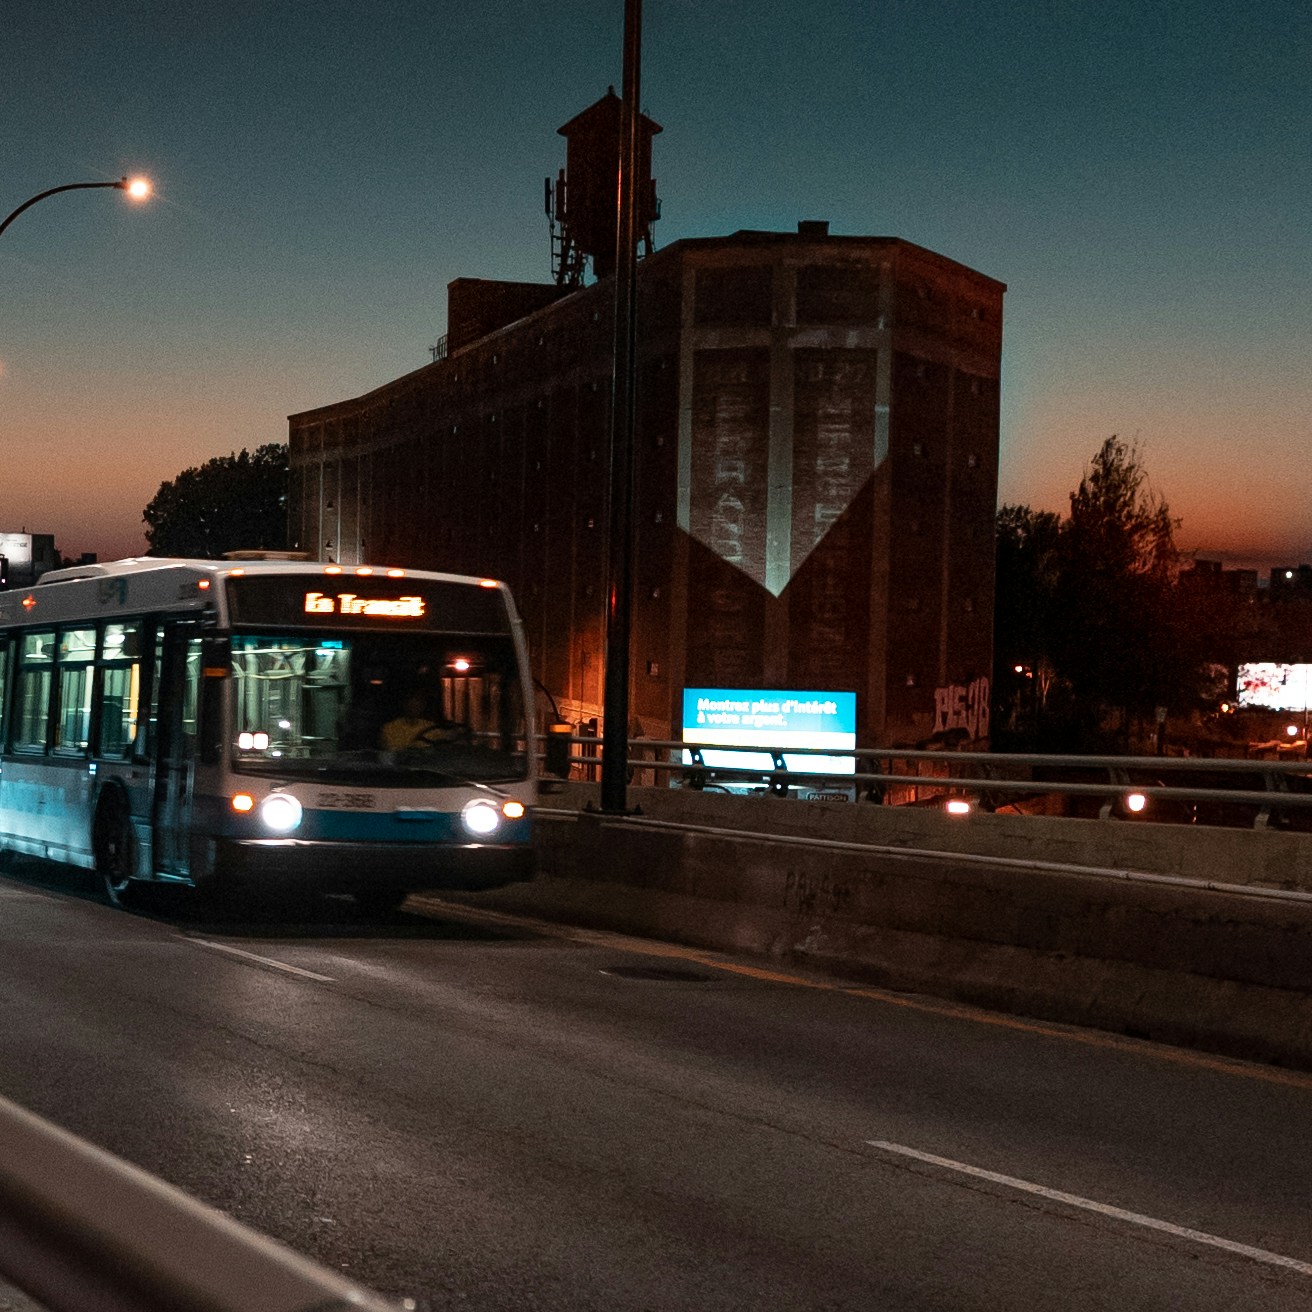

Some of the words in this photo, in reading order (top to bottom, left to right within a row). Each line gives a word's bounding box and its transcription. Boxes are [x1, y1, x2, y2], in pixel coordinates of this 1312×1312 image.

[697, 698, 750, 713] Montrez
[751, 699, 779, 715] plus
[781, 699, 837, 715] d'intérêt
[697, 710, 706, 724] à
[707, 712, 741, 725] votre
